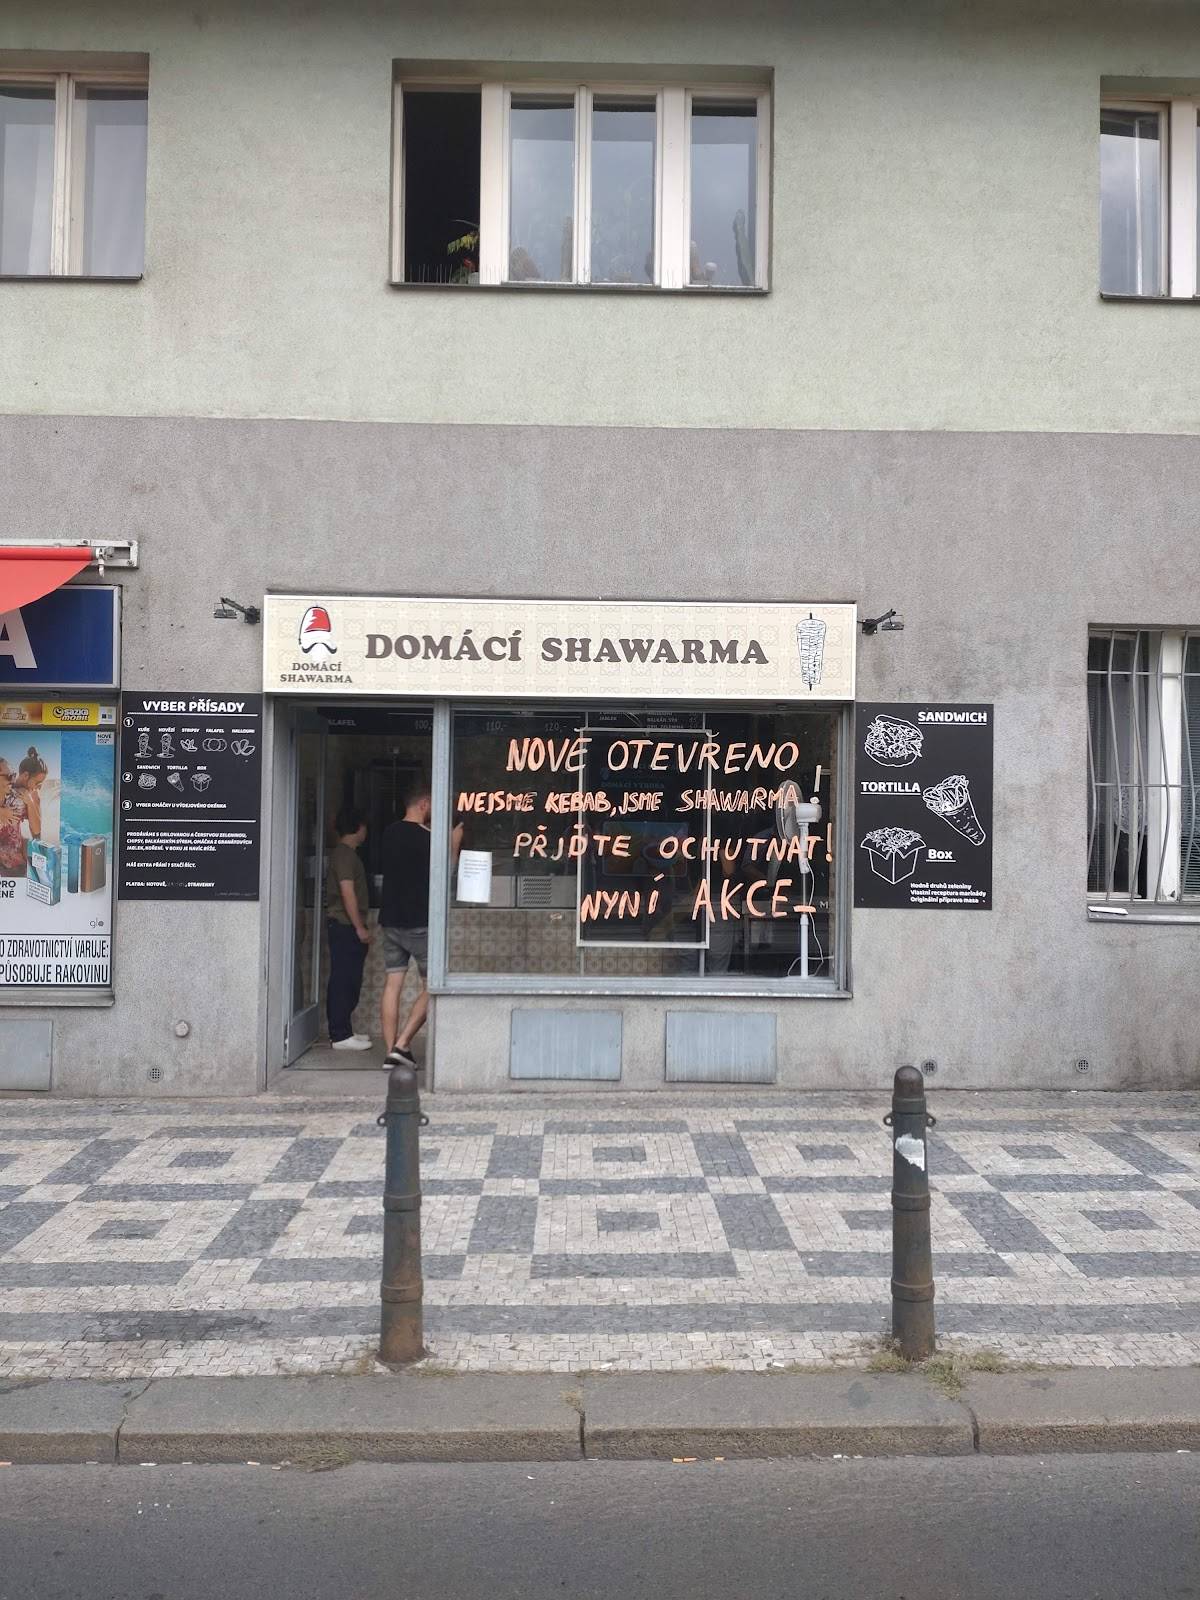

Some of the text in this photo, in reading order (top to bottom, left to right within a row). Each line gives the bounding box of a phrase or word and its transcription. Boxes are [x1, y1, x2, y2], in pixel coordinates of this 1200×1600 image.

[366, 629, 769, 665] DOMÁCÍ SHAWARMA
[292, 661, 342, 672] DOMÁCÍ
[280, 674, 353, 683] SHAWARMA
[143, 699, 245, 712] VYBER PŘÍSADY
[918, 711, 987, 723] SANDWICH
[861, 782, 921, 793] TORTILLA
[457, 790, 537, 814] NEJSME
[928, 849, 953, 860] Box
[0, 880, 16, 888] RO
[0, 888, 15, 898] NÉ
[581, 873, 665, 923] NYNÍ
[7, 937, 72, 958] ZDRAVOTNICTVÍ
[75, 940, 109, 958] VARUJE:
[55, 964, 108, 983] RAKOVINU
